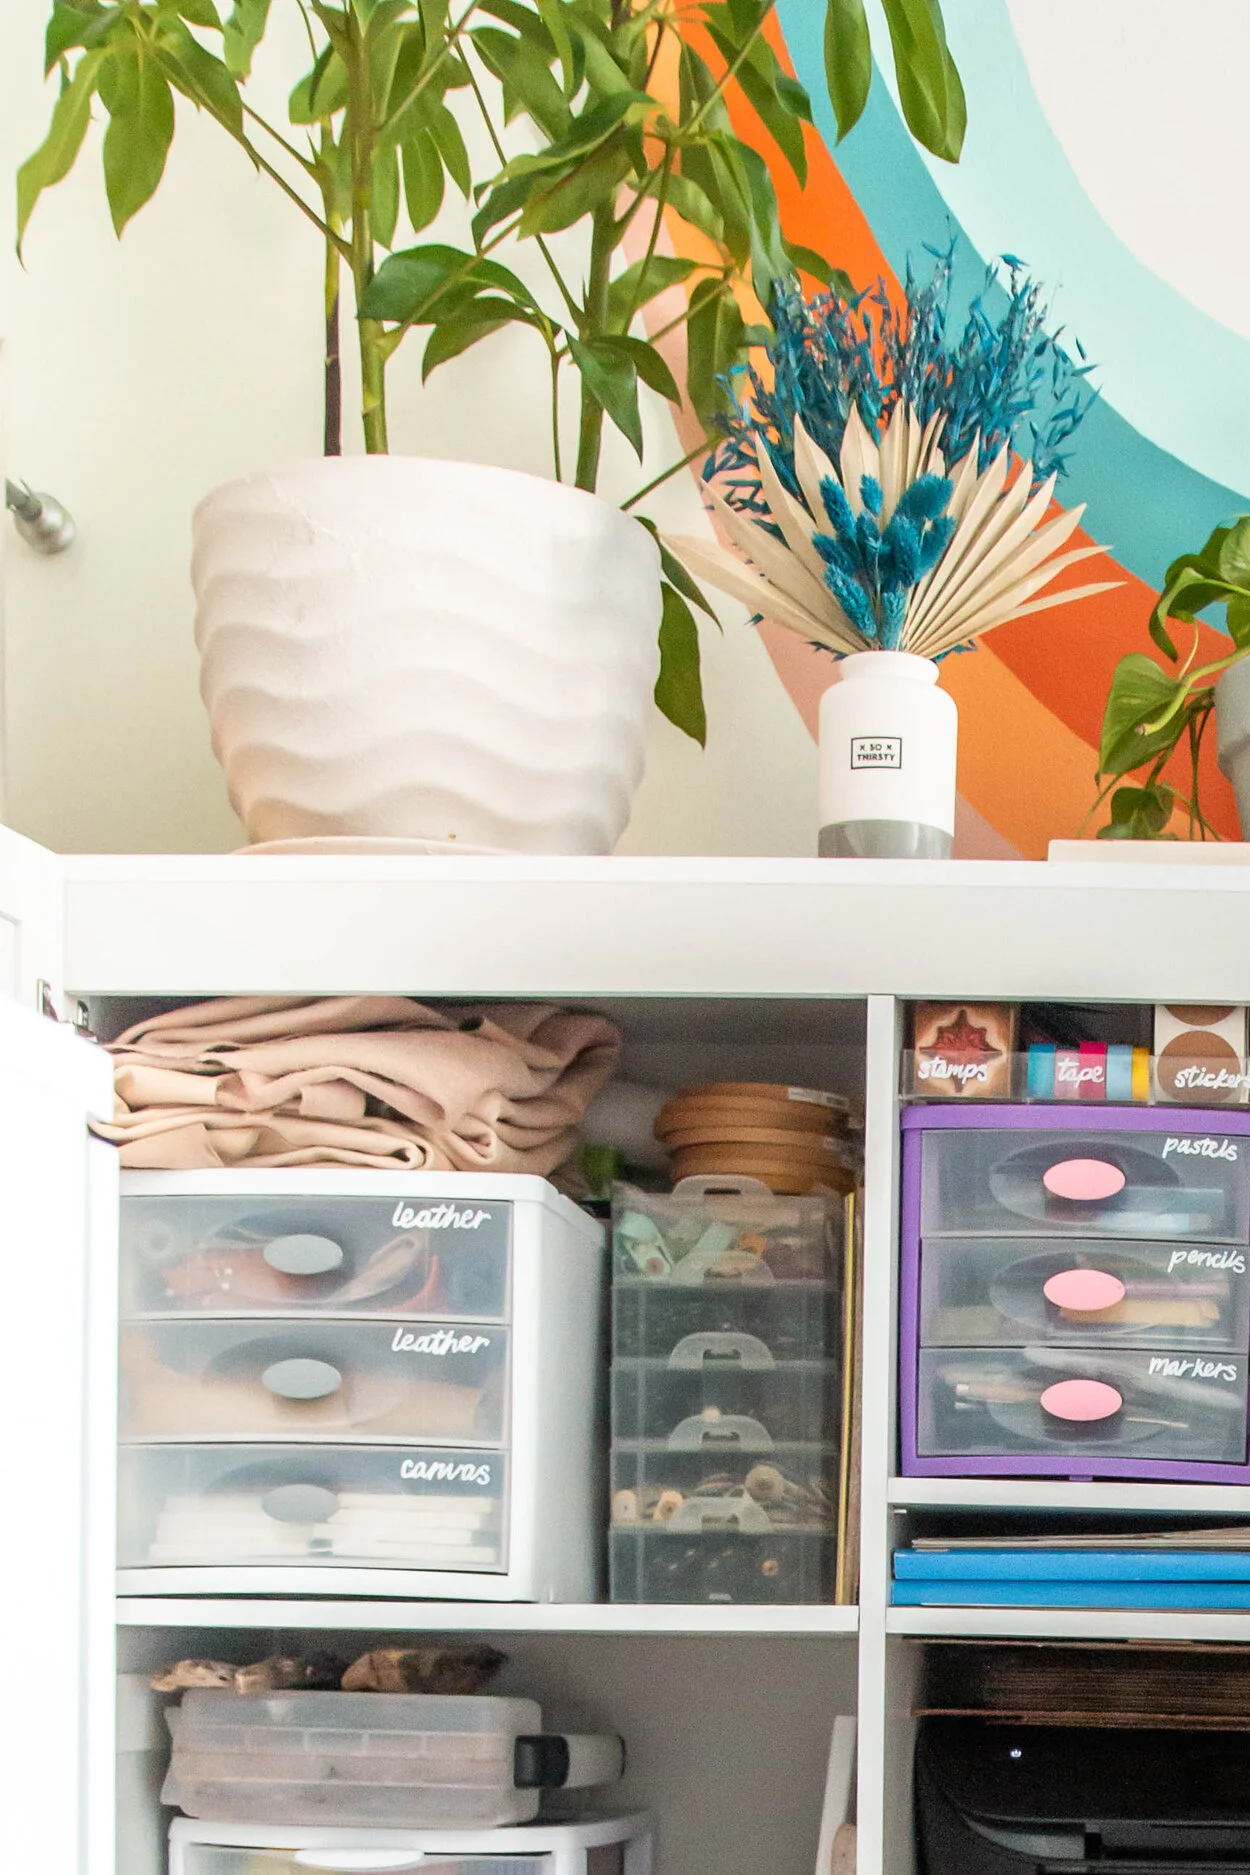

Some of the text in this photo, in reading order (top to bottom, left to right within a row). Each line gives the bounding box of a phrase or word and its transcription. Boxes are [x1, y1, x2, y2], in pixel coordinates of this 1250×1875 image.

[857, 753, 896, 762] THIRSTY
[917, 1057, 989, 1083] stamps
[1056, 1062, 1106, 1085] tape
[1162, 1134, 1238, 1162] pastels
[392, 1202, 491, 1231] leather
[1168, 1247, 1246, 1274] pencils
[391, 1328, 490, 1356] leather
[1148, 1354, 1237, 1382] markers
[400, 1458, 490, 1486] canvas
